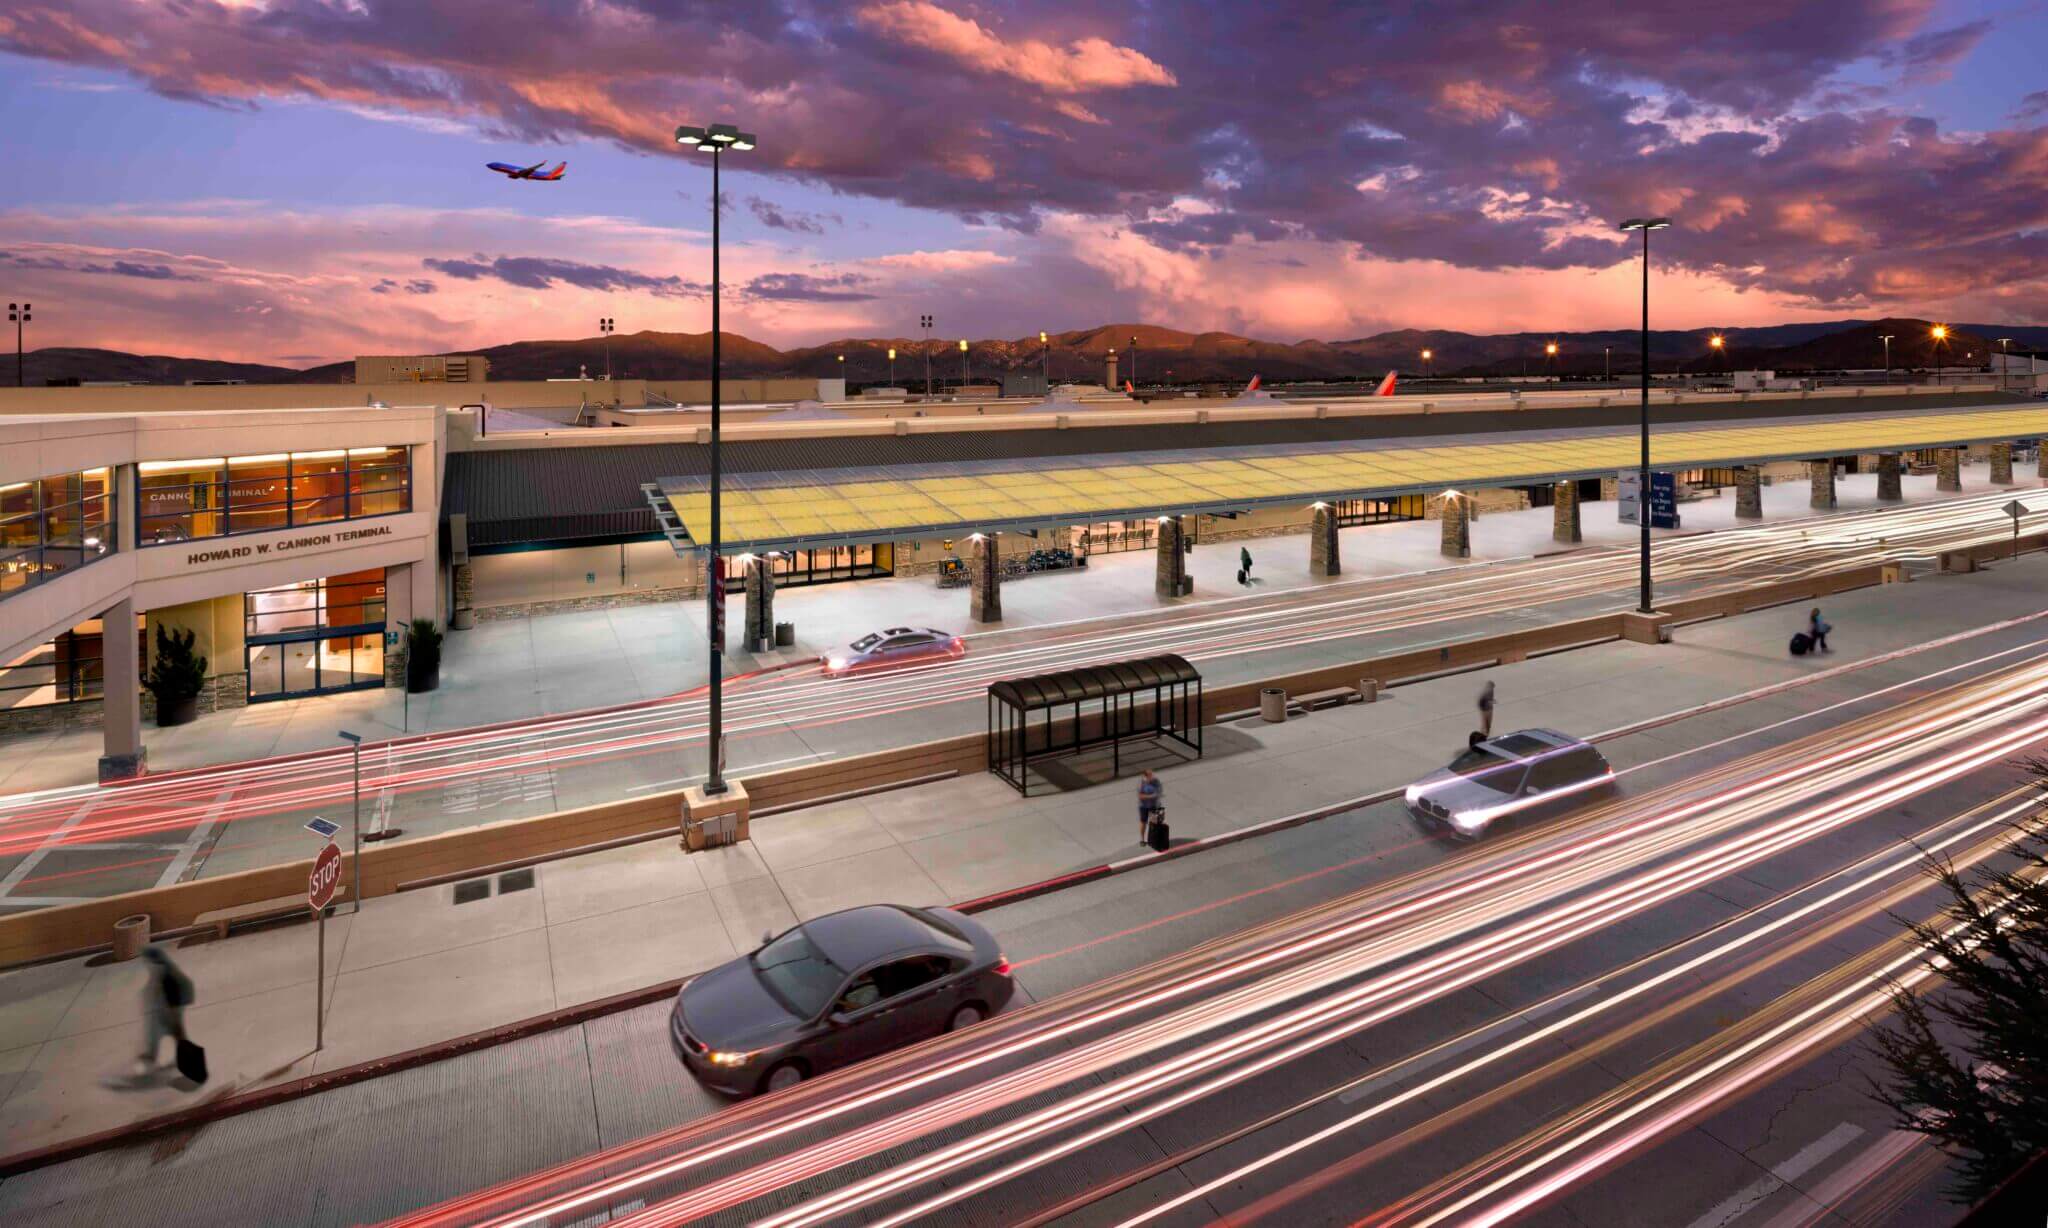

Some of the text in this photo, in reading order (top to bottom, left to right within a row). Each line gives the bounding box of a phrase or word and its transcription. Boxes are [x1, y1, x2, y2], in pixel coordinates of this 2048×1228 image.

[187, 526, 392, 564] HOWARD W. CANNON TERMINAL
[311, 855, 339, 896] STOP
